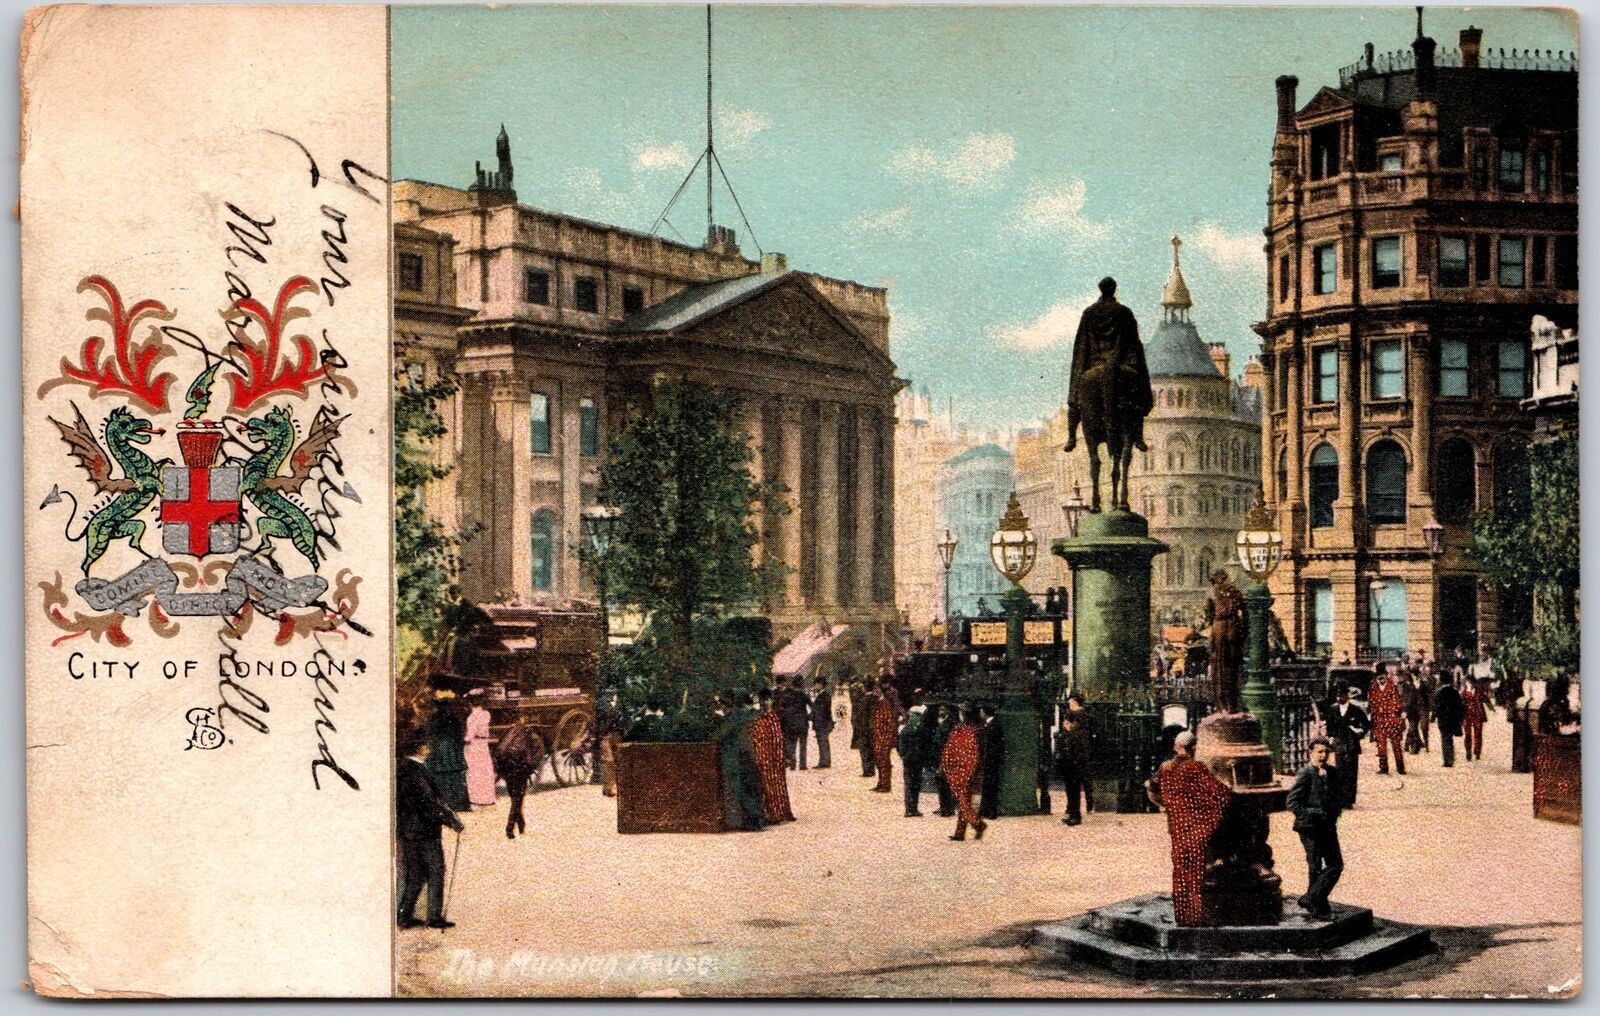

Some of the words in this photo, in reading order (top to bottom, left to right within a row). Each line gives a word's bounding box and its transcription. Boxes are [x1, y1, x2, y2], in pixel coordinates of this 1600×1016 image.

[162, 202, 276, 378] Mary
[258, 126, 390, 306] Your
[162, 661, 199, 680] OF
